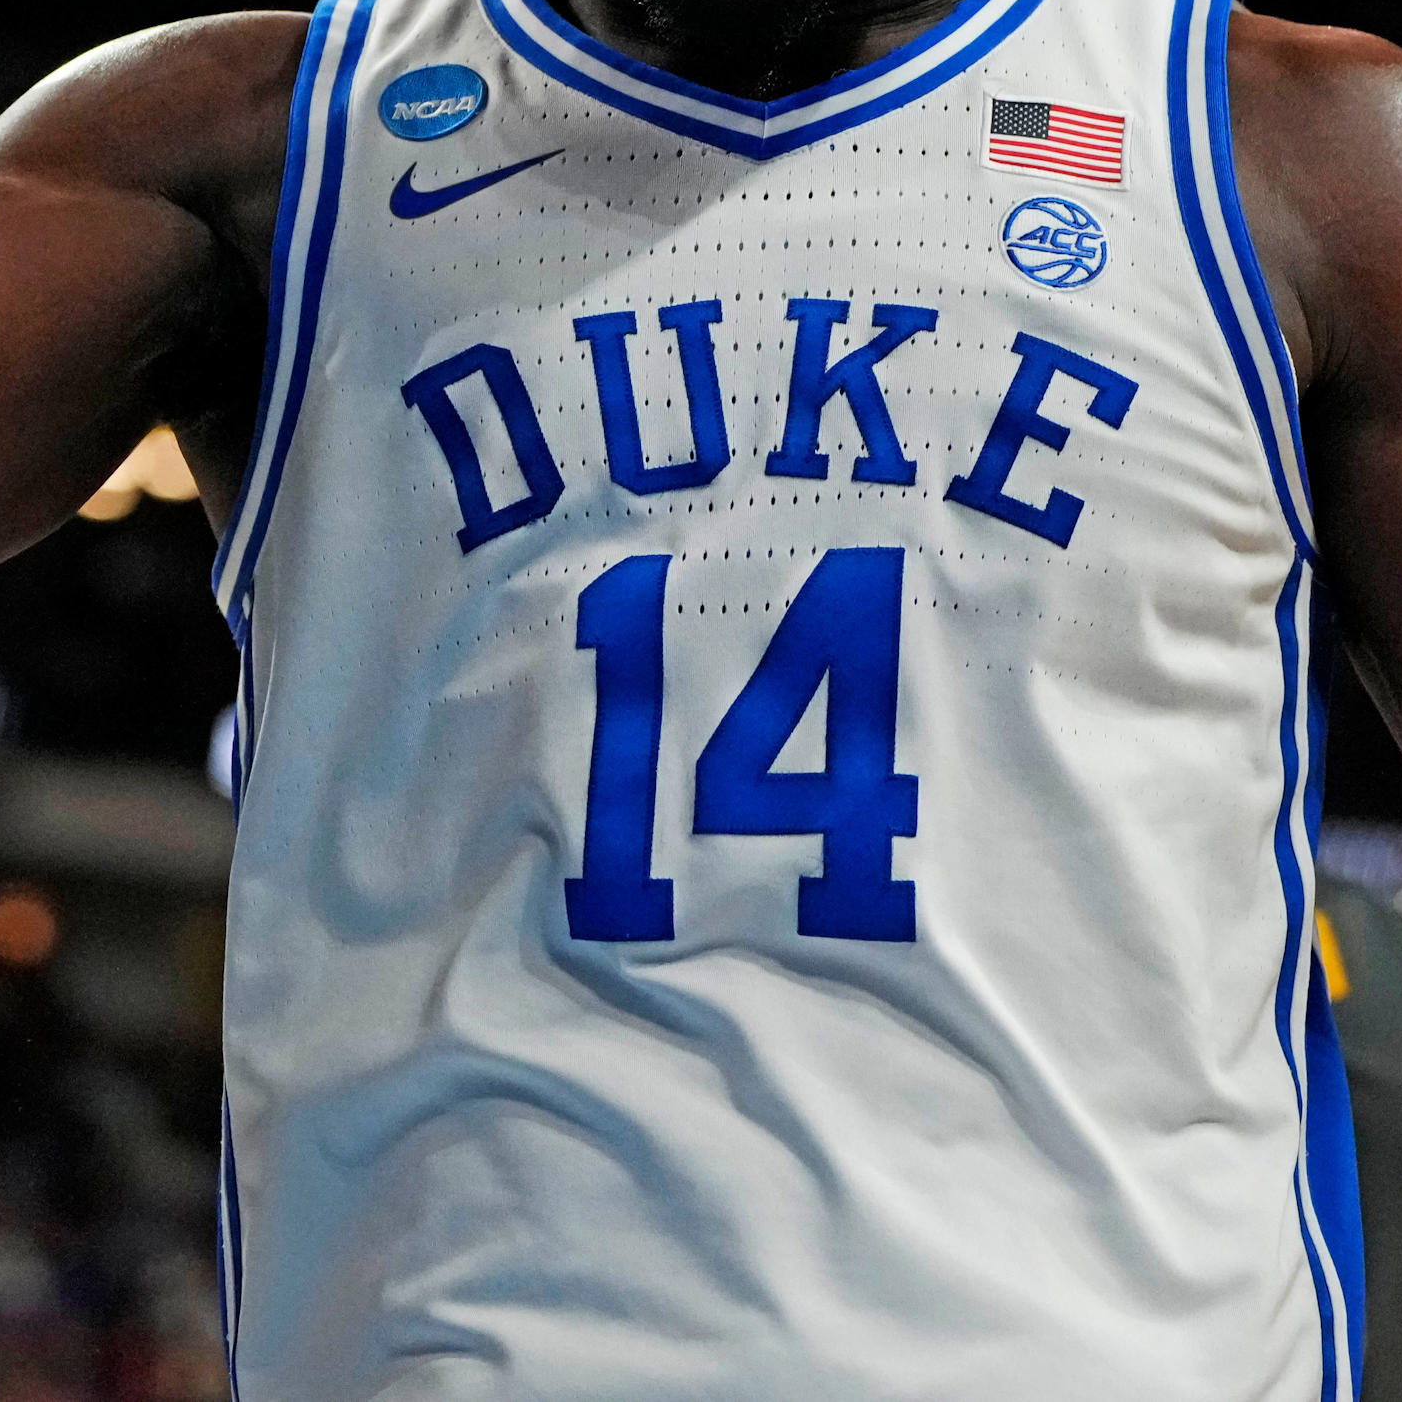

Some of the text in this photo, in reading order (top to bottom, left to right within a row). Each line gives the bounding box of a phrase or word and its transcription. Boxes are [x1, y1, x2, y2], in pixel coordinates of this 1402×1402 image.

[391, 95, 476, 121] NCAA
[1017, 225, 1104, 255] ACC
[400, 298, 1139, 556] DUKE
[564, 546, 919, 942] 14
